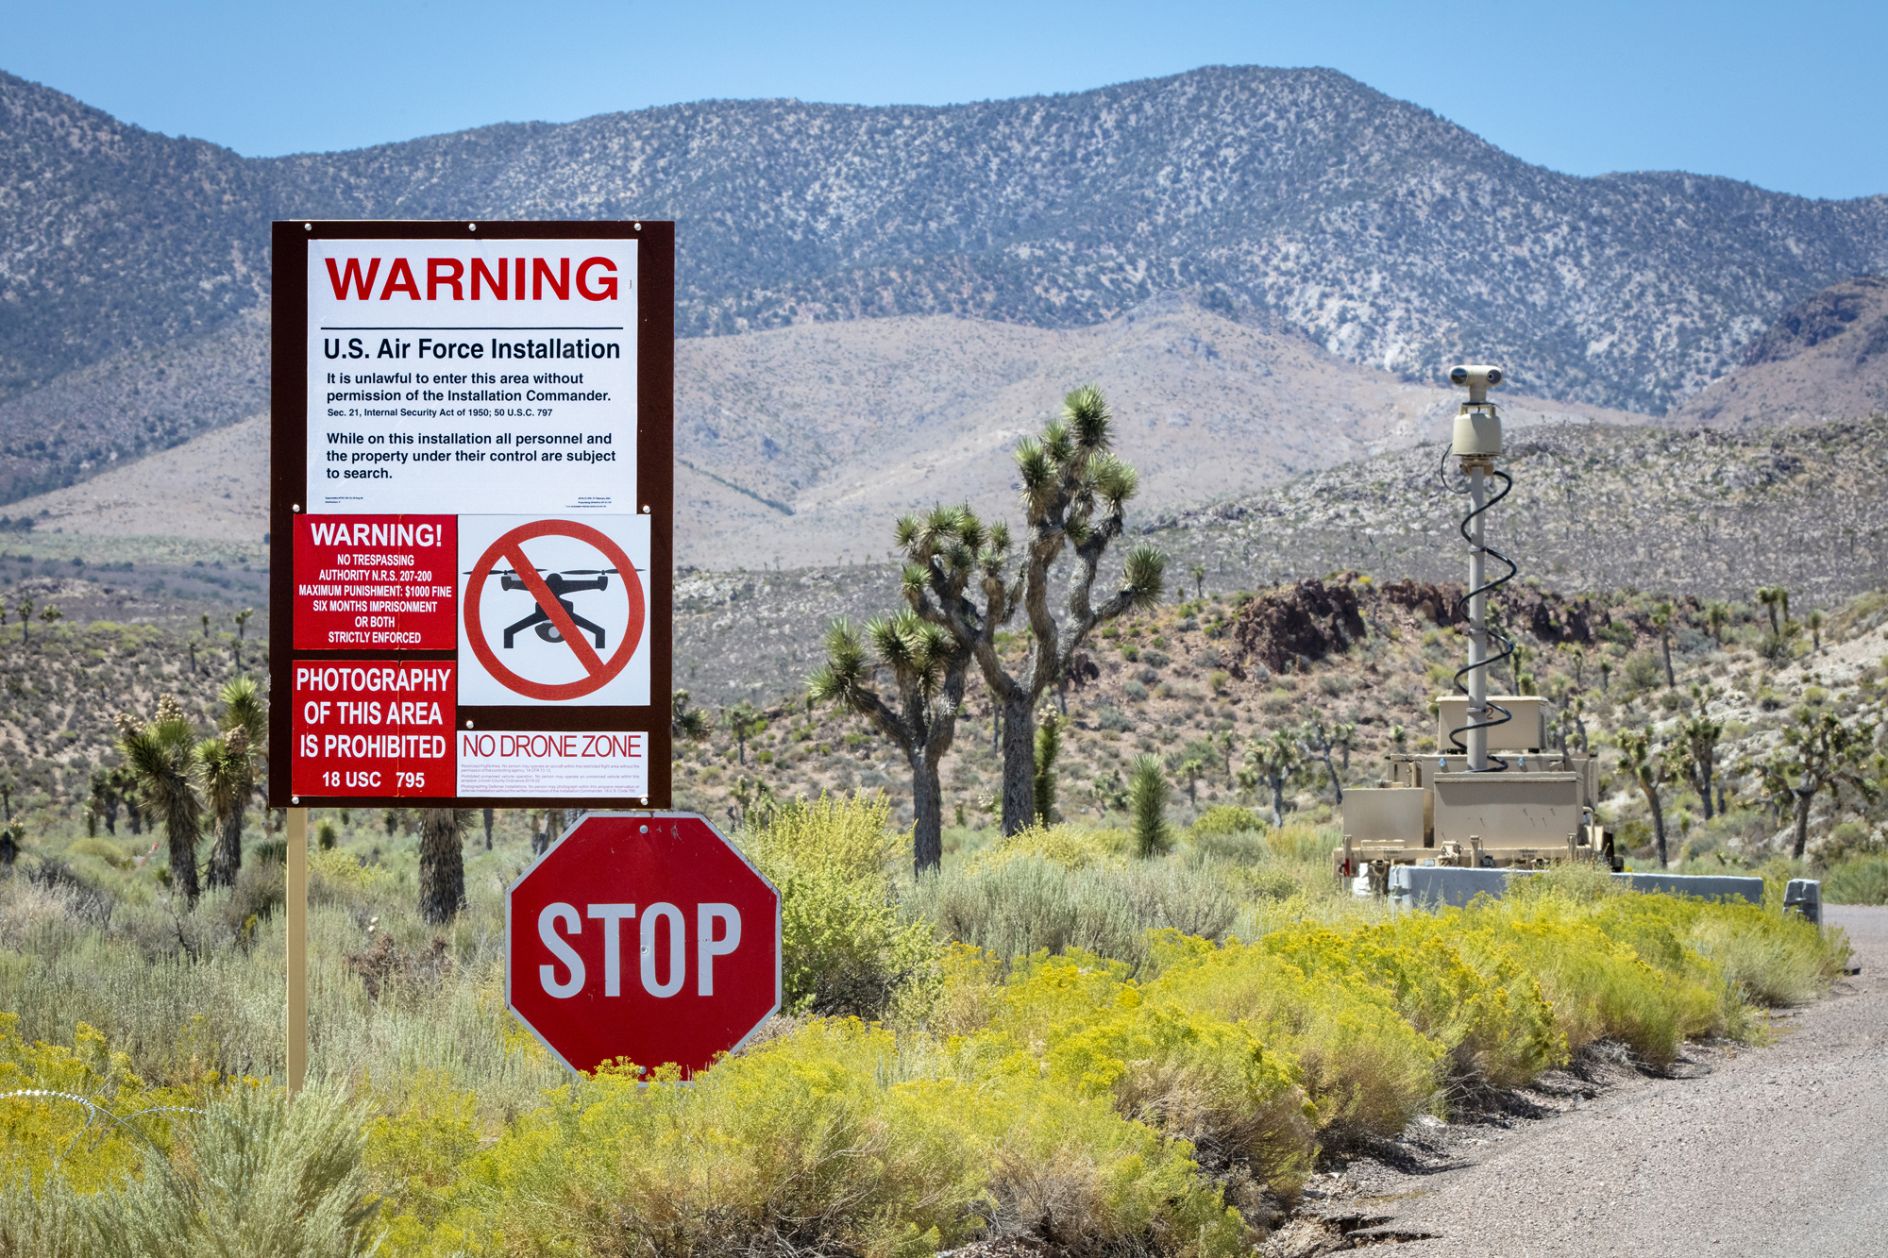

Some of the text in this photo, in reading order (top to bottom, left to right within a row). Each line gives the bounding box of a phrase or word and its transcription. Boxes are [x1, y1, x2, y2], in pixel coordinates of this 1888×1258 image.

[325, 257, 618, 301] WARNING
[325, 338, 619, 359] U.S. Air Force Installation
[326, 372, 583, 385] It is unlawful to enter this area without
[327, 389, 610, 404] permission of the Installation Commander.
[327, 407, 553, 419] Sec. 21, Internal Security Act of 1950; 50 U.S.C. 797
[326, 432, 611, 447] While on this installation all personnel and
[326, 449, 616, 464] the property under their control are subject
[326, 467, 392, 479] to search.
[311, 523, 441, 547] WARNING!
[337, 553, 414, 567] NO TRESPASSING
[318, 569, 432, 582] AUTHORITY N.R.S. 207-200
[298, 584, 452, 598] MAXIMUM PUNISHMENT: $1000 FINE
[312, 599, 437, 613] SIX MONTHS IMPRISONMENT
[354, 615, 395, 628] OR BOTH
[327, 630, 421, 644] STRICTLY ENFORCED
[297, 668, 451, 691] PHOTOGRAPHY
[304, 701, 443, 725] OF THIS AREA
[301, 735, 446, 758] IS PROHIBITED
[464, 735, 641, 757] NO DRONE ZONE
[323, 771, 425, 787] 18 USC 795
[538, 902, 742, 999] STOP
